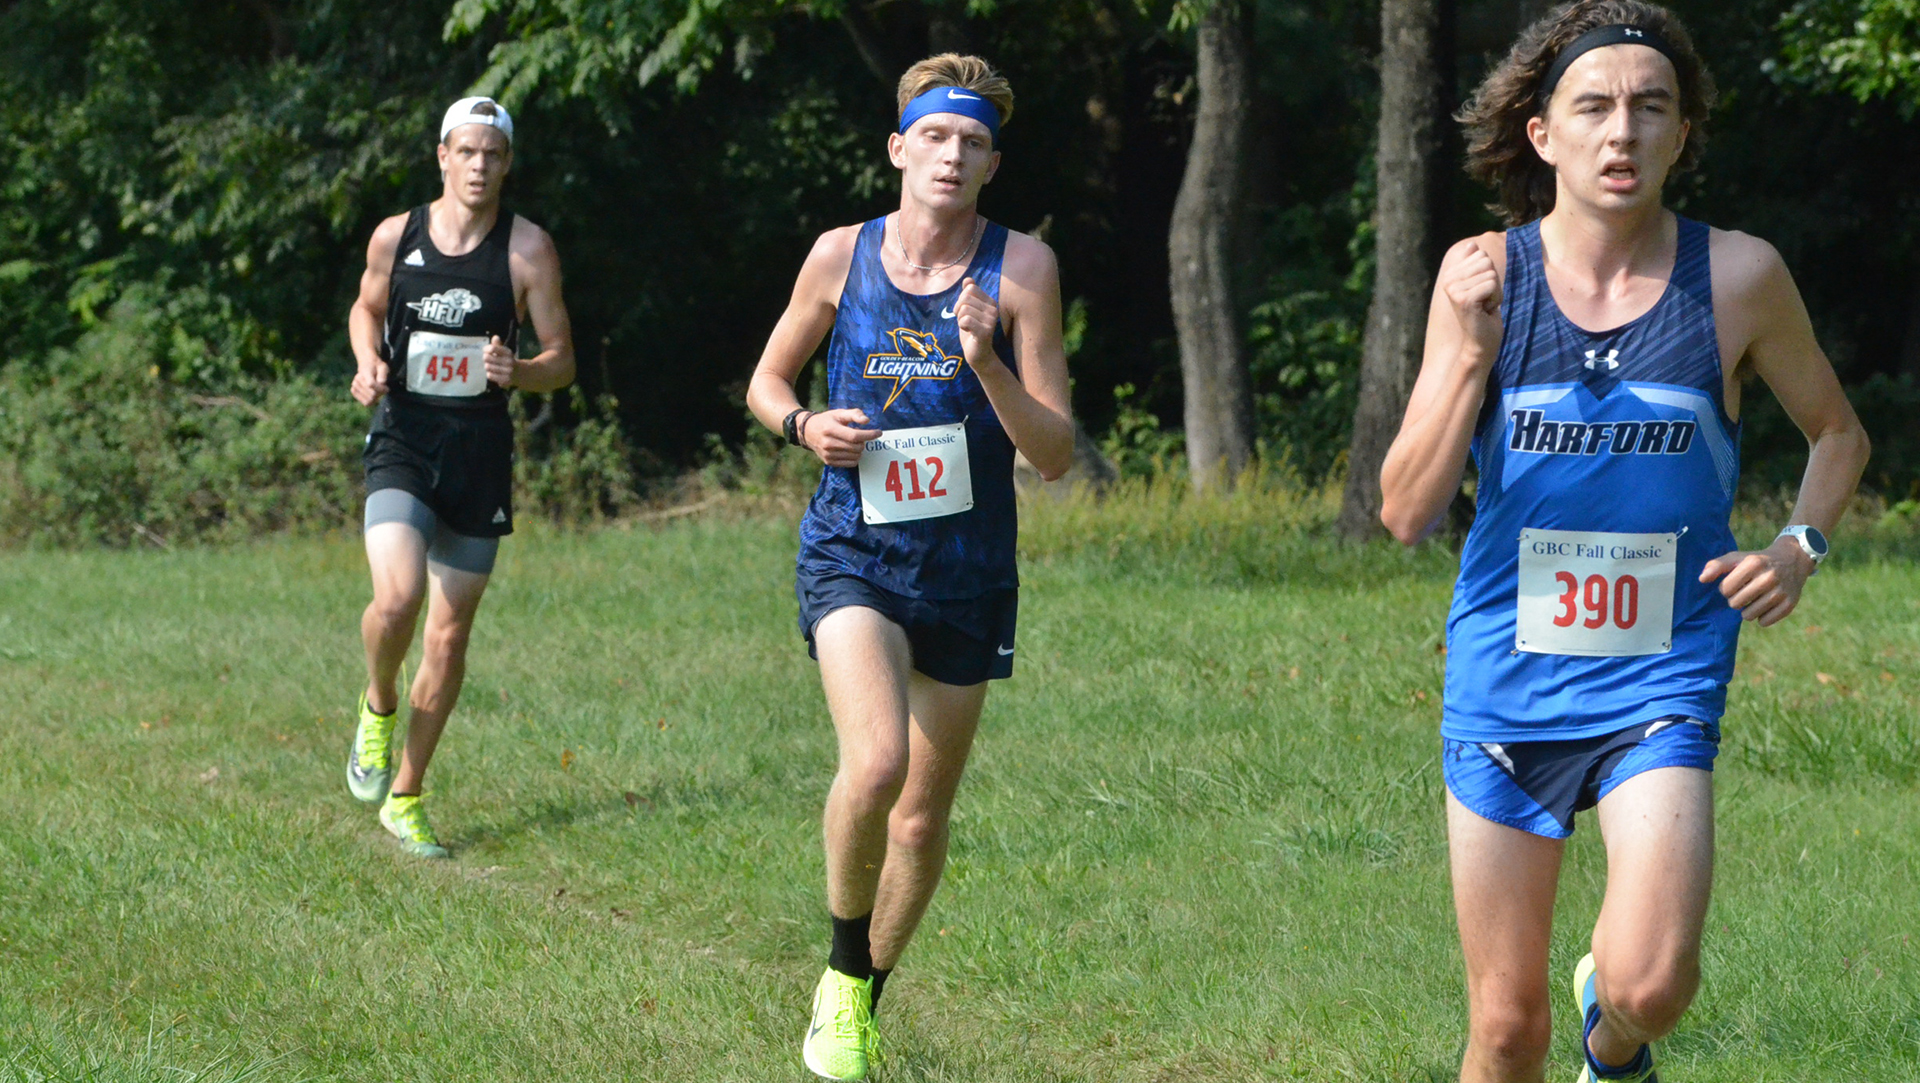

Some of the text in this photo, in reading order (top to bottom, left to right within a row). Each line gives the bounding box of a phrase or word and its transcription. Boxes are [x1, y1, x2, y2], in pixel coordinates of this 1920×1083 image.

[421, 300, 463, 325] HFU
[426, 355, 469, 383] 454
[867, 358, 957, 384] LIGHTNING
[865, 434, 956, 452] GBC Fall Classic
[1510, 409, 1697, 456] HARFORD
[885, 456, 947, 502] 412
[1532, 541, 1662, 560] GBC Fall Classic
[1553, 571, 1639, 630] 390
